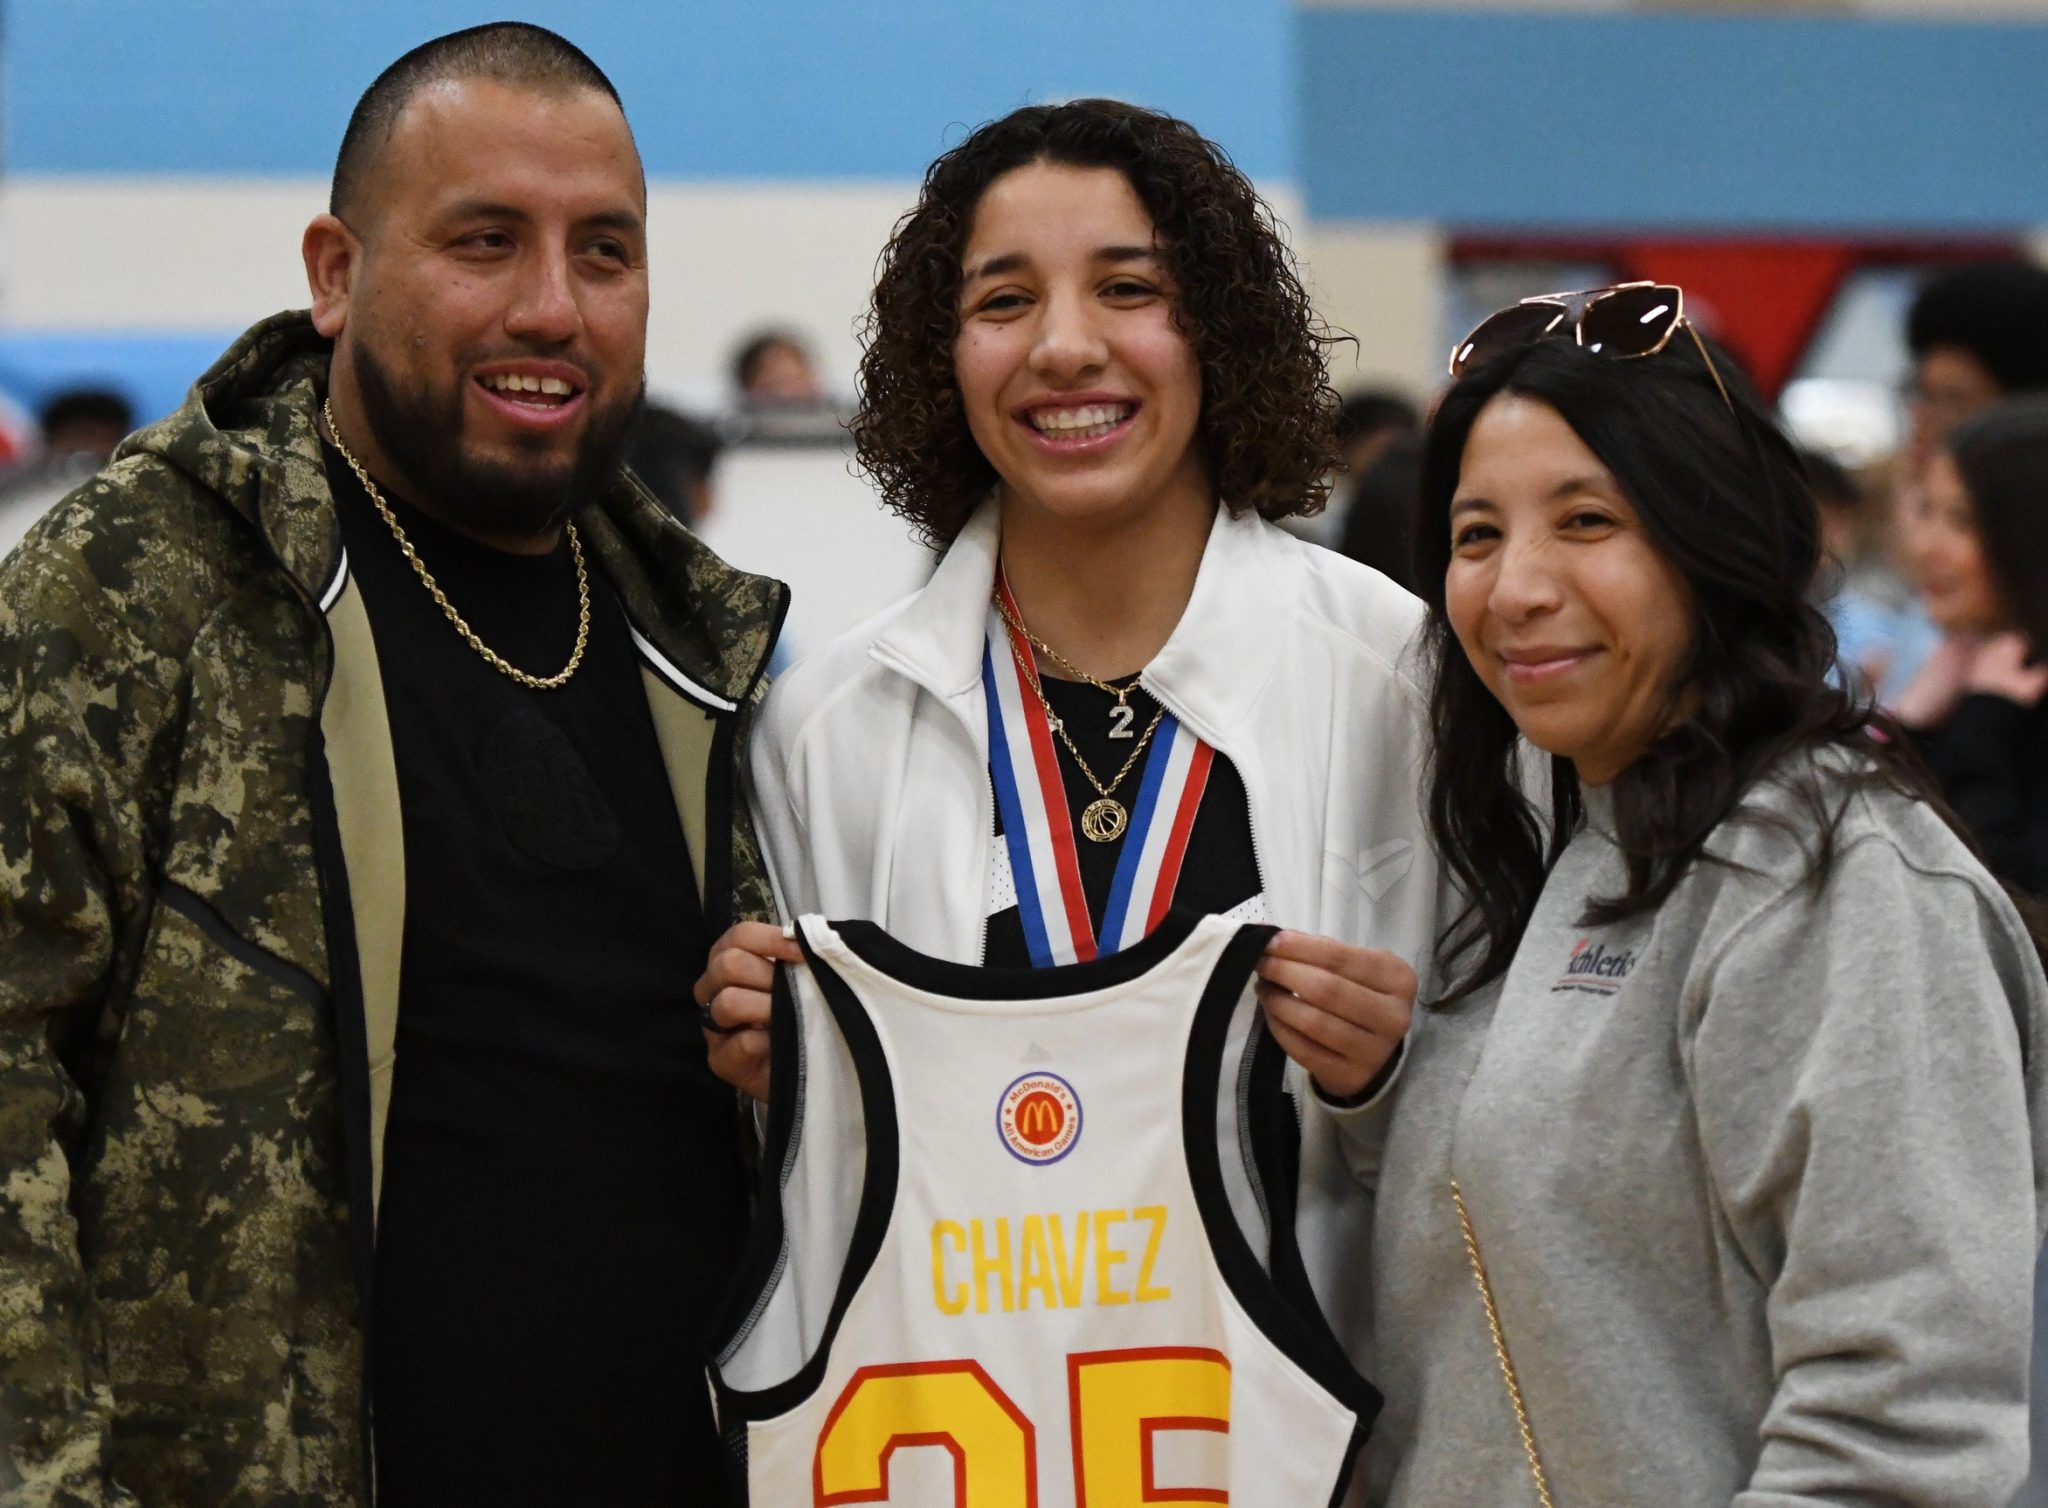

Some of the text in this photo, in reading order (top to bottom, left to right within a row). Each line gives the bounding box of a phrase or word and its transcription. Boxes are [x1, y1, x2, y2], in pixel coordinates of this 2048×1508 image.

[1108, 705, 1134, 739] 2
[1010, 1081, 1066, 1103] McDonald's
[1004, 1117, 1075, 1157] All American Games
[930, 1205, 1172, 1316] CHAVEZ
